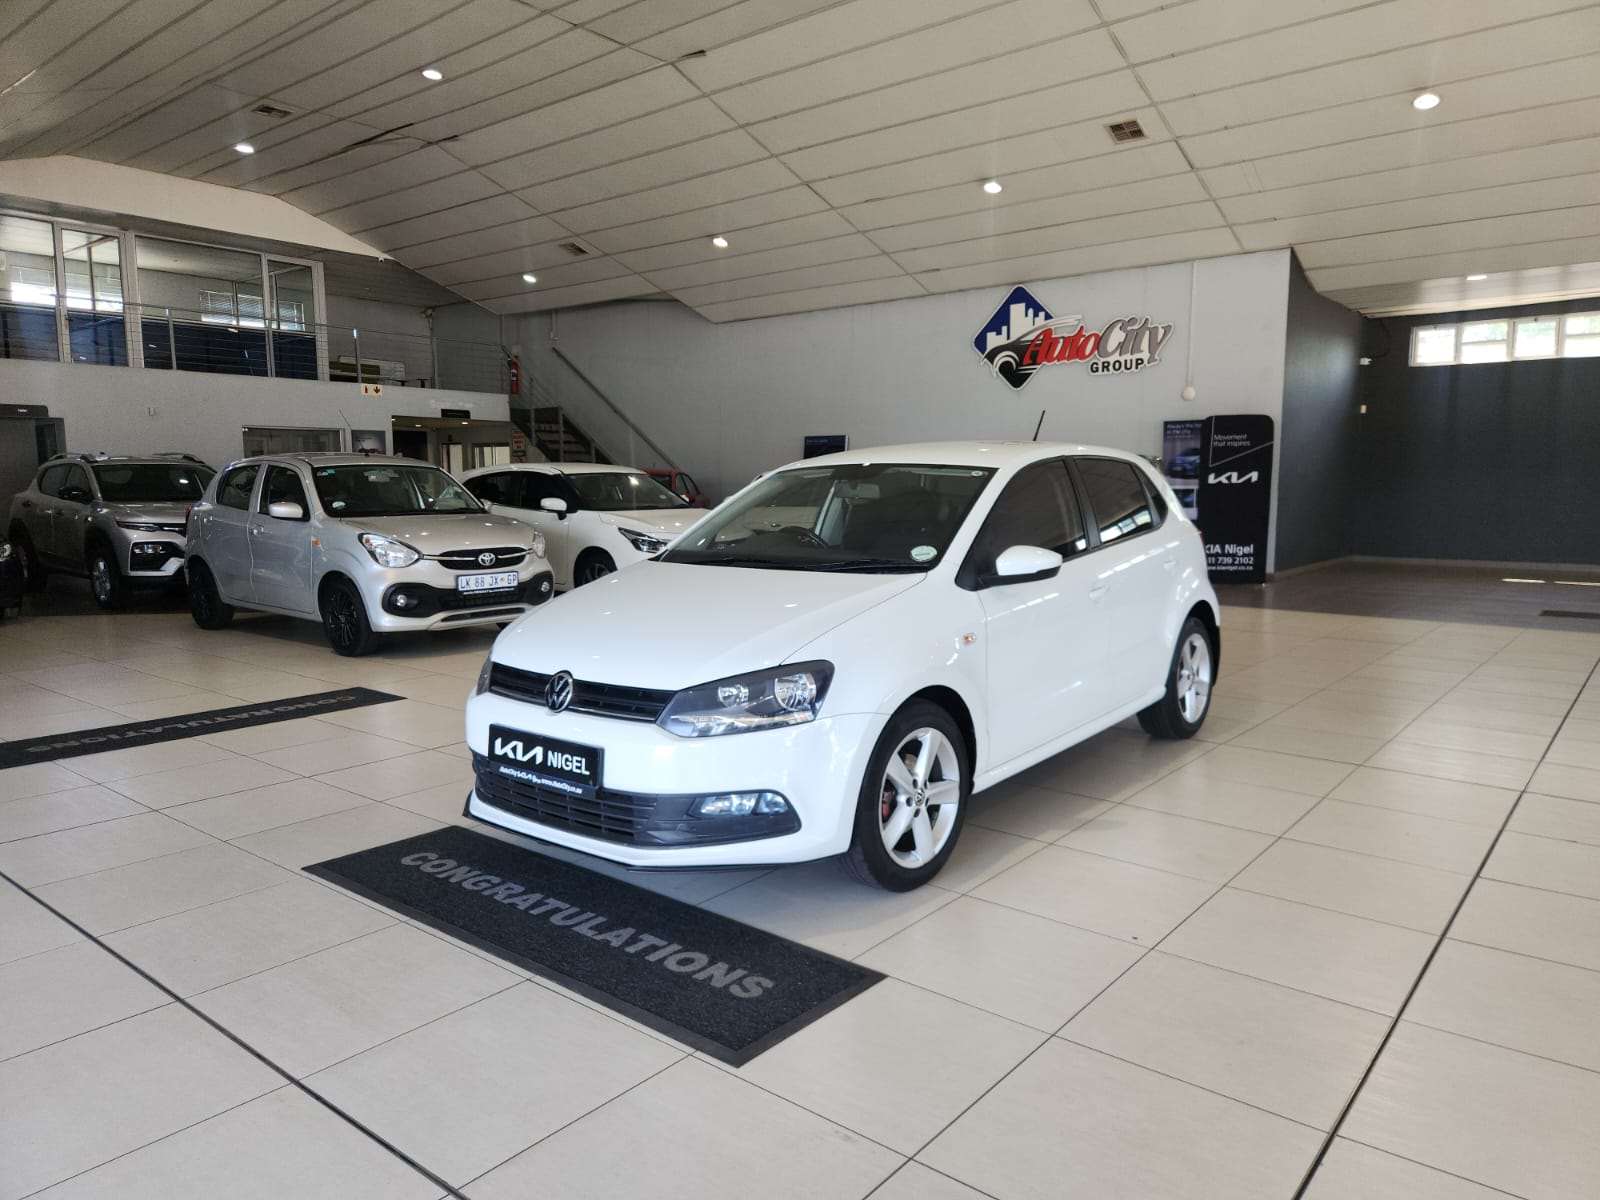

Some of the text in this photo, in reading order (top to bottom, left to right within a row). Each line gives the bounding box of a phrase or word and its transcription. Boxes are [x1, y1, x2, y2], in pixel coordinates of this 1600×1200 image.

[1089, 358, 1145, 374] GROUP
[1207, 470, 1259, 484] KIA
[1224, 543, 1254, 556] Nigel
[1234, 556, 1254, 564] 2102
[507, 573, 517, 585] GP
[494, 736, 591, 776] KIA NIGEL
[400, 851, 775, 999] CONGRATULATIONS
